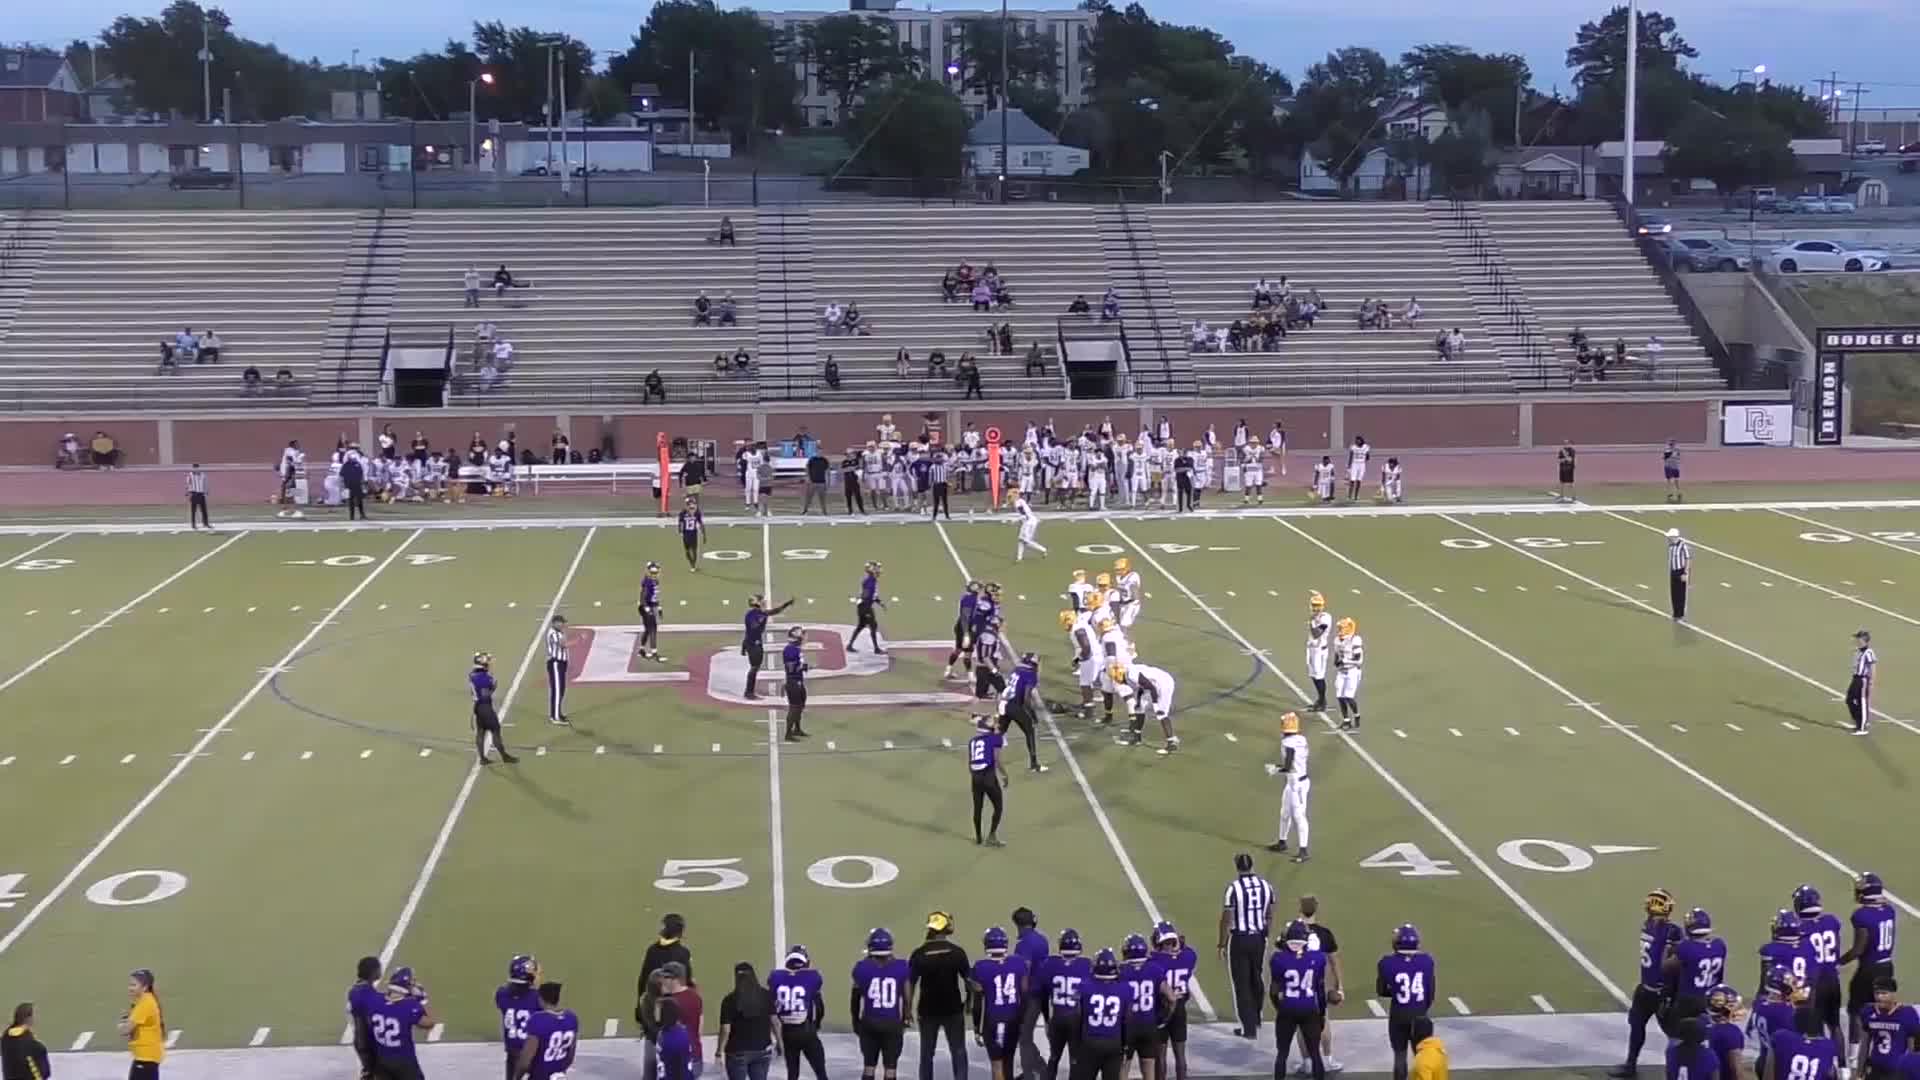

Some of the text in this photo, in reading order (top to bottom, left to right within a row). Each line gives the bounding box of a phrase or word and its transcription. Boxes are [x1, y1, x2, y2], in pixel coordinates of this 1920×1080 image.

[1826, 335, 1893, 346] DODGE
[1822, 361, 1836, 433] DEMON
[1745, 408, 1774, 440] DC
[971, 740, 985, 761] 12
[1359, 838, 1594, 876] 40
[652, 854, 900, 893] 50
[1246, 887, 1262, 909] H
[1810, 930, 1837, 964] 92
[1166, 969, 1188, 995] 15
[1284, 969, 1314, 998] 24
[1395, 972, 1424, 1004] 34
[1694, 957, 1722, 988] 32
[868, 977, 897, 1009] 40
[993, 973, 1016, 1005] 14
[1052, 975, 1081, 1006] 25
[1089, 994, 1120, 1027] 33
[371, 1015, 401, 1047] 22
[543, 1031, 575, 1062] 82
[1878, 1031, 1891, 1054] 3
